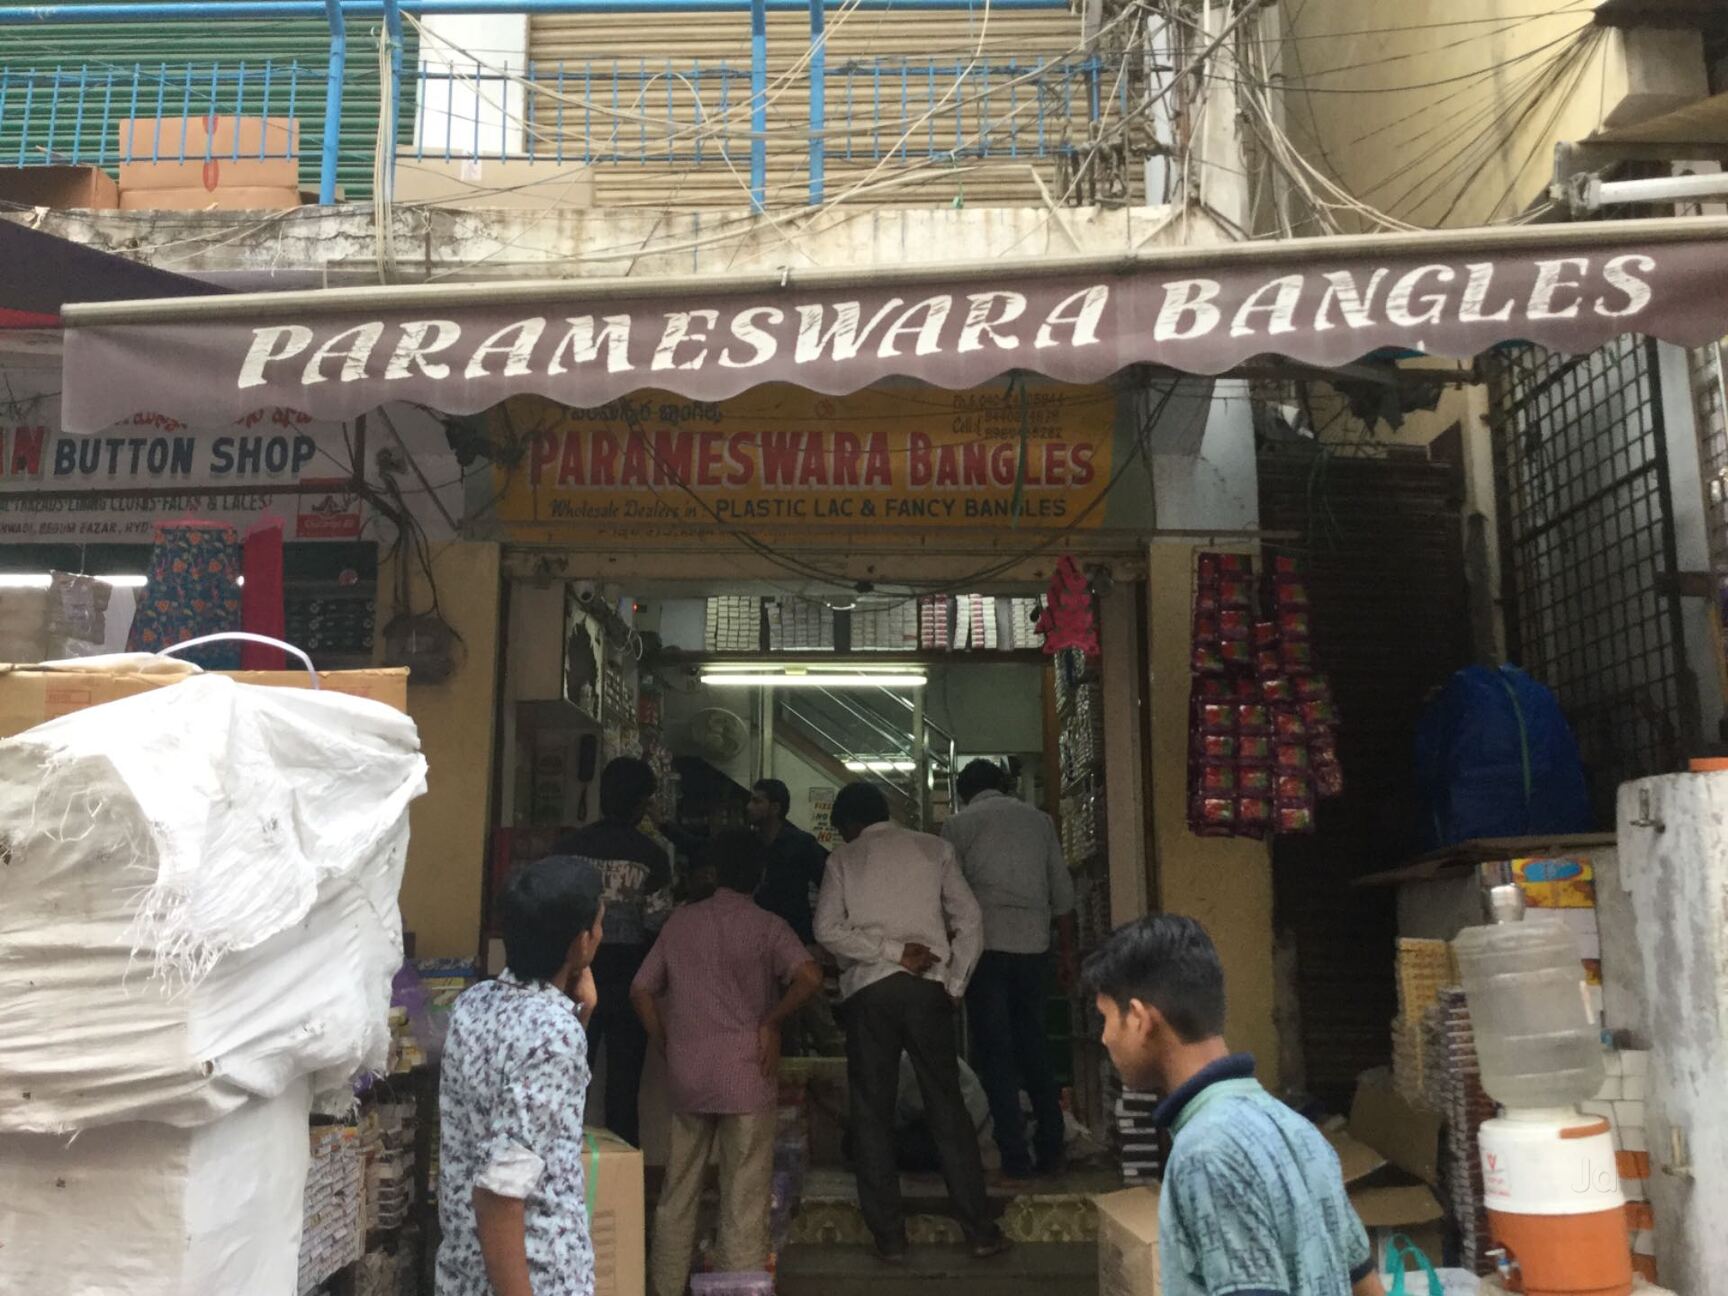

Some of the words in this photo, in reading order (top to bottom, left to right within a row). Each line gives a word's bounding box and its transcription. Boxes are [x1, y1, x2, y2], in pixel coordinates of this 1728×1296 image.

[237, 284, 1109, 389] PARAMESWARA
[1153, 253, 1657, 341] BANGLES
[0, 425, 44, 475] N
[54, 436, 196, 476] BUTTON
[209, 435, 317, 474] SHOP
[529, 431, 893, 487] PARAMESWARA
[908, 431, 1096, 487] BANGLES
[549, 499, 619, 519] Wholesale
[623, 499, 680, 519] Dealers
[715, 499, 807, 518] PLASTIC
[813, 498, 854, 518] LAC
[860, 499, 877, 517] &
[885, 498, 960, 518] FANCY
